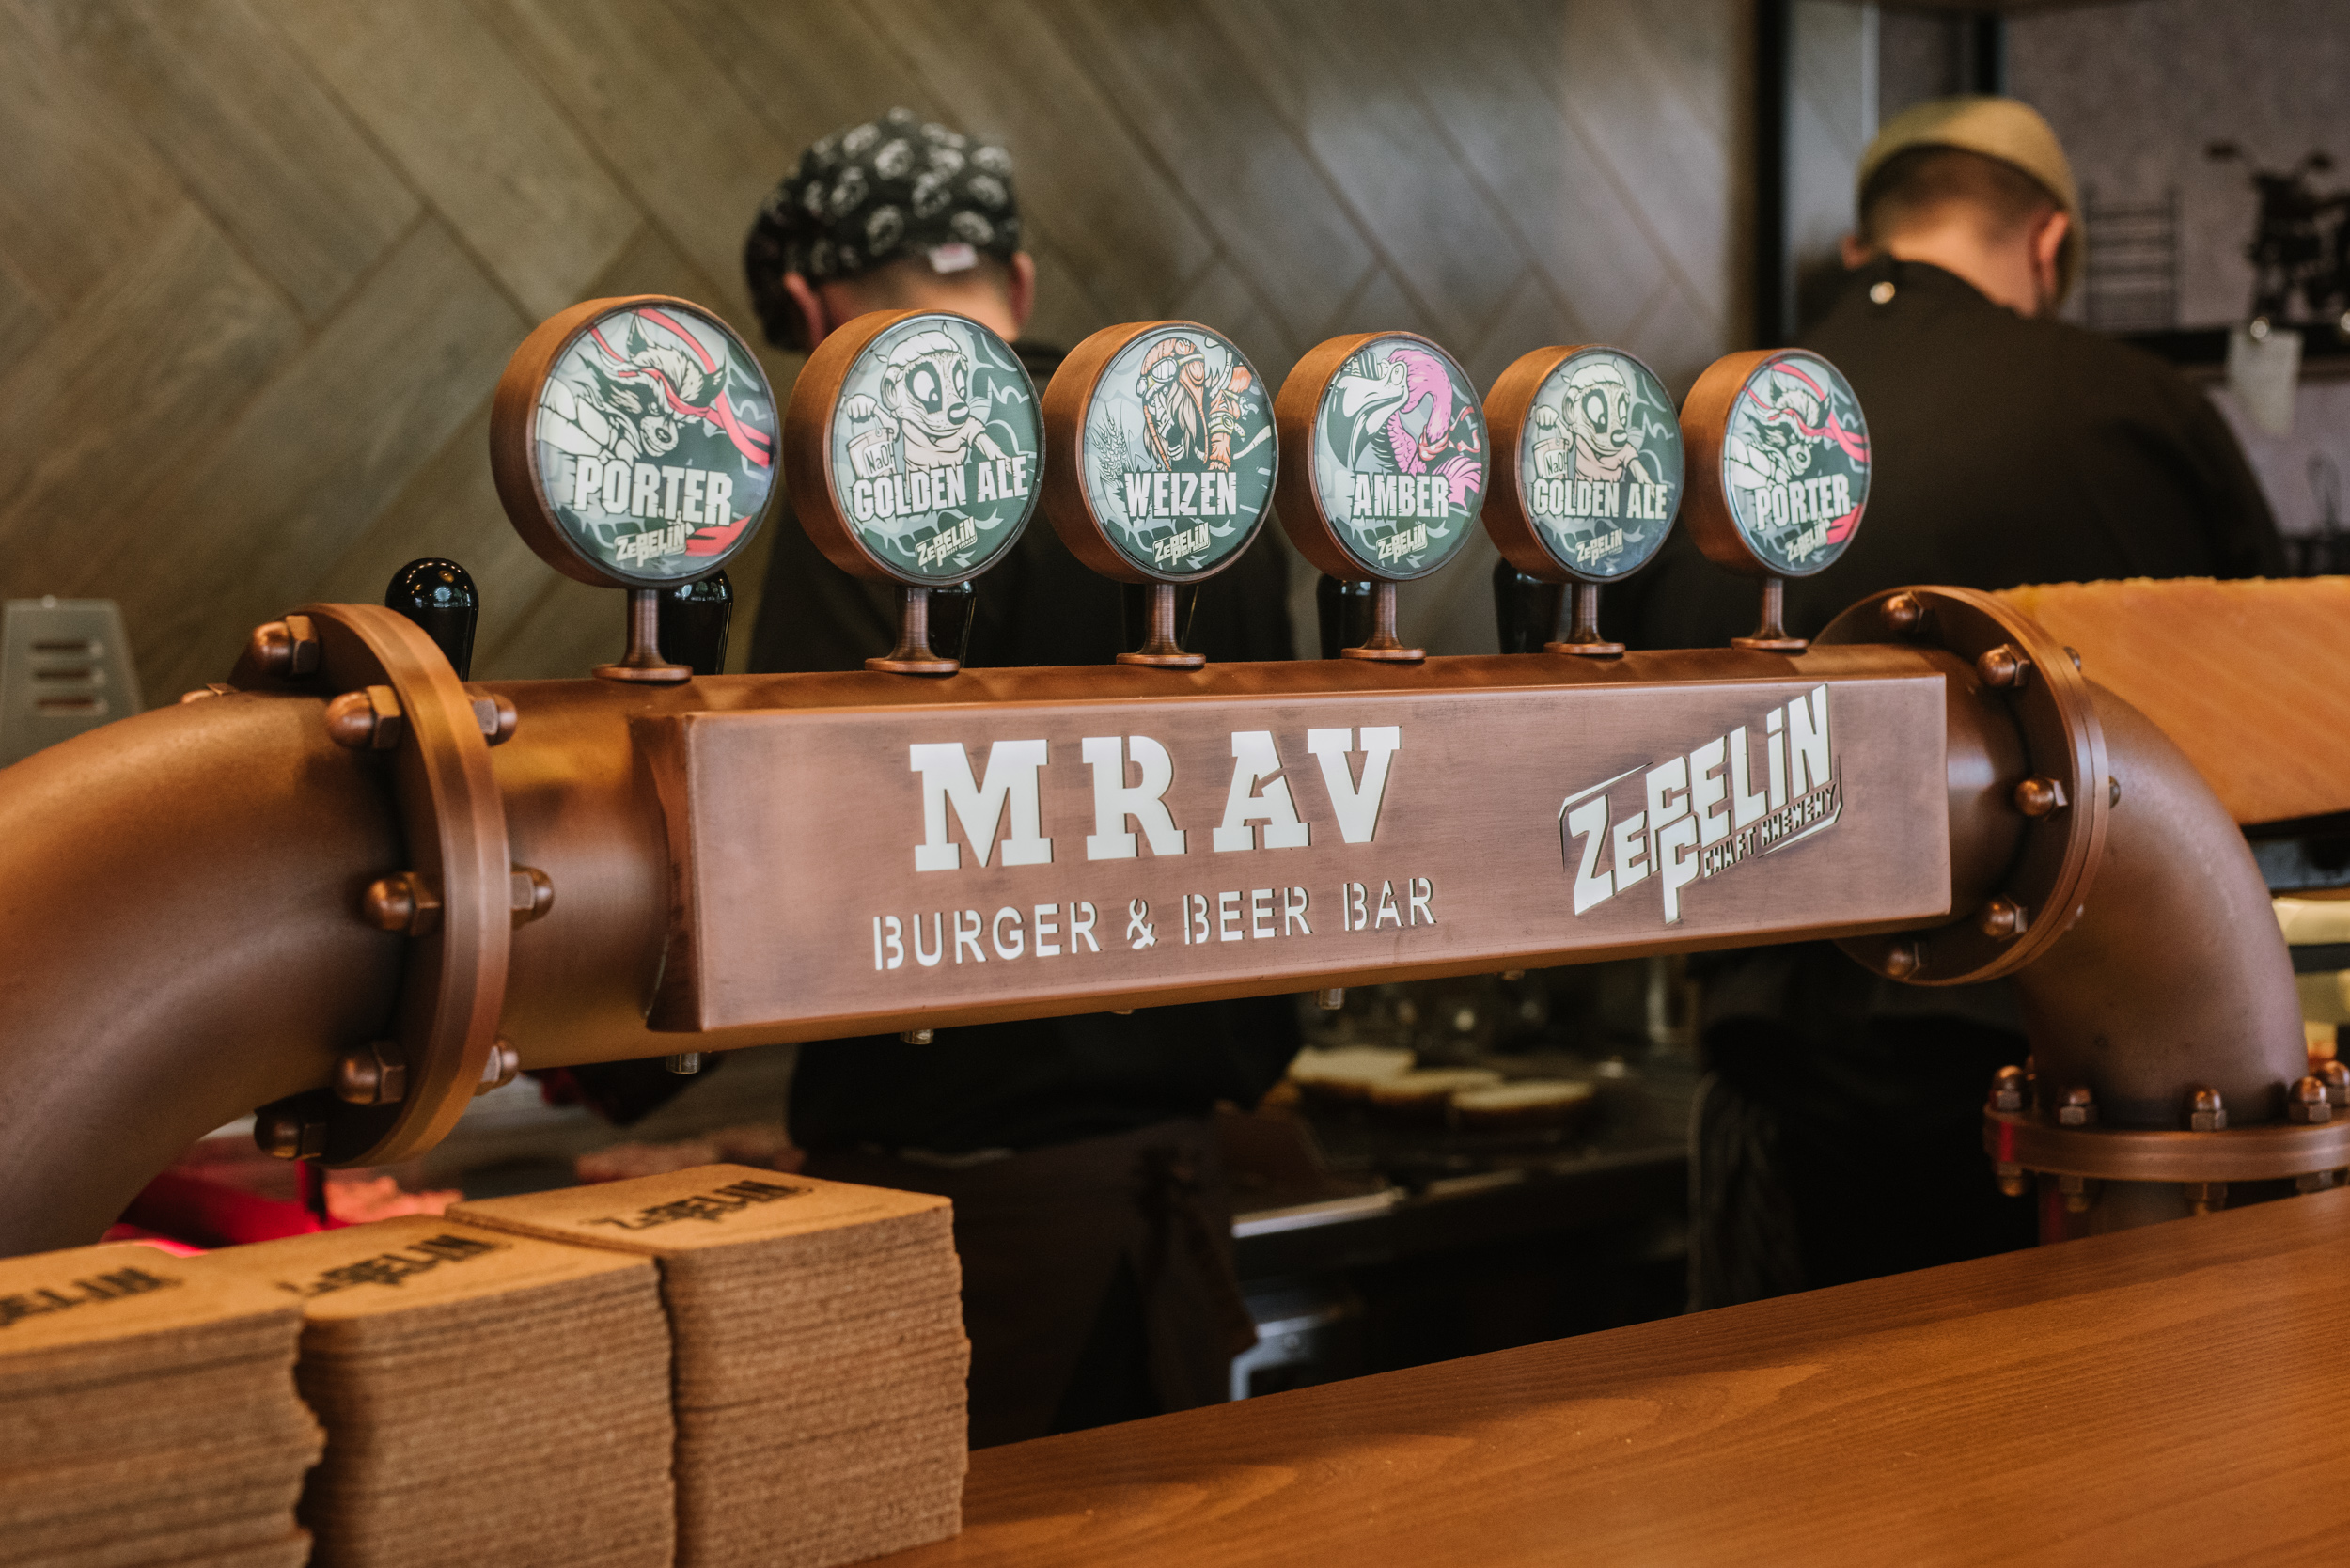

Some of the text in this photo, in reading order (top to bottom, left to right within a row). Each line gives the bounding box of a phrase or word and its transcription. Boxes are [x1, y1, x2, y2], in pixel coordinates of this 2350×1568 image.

[573, 457, 733, 526] PORTER
[853, 455, 1029, 522] GOLDEN ALE
[1124, 472, 1237, 517] WEIZEN
[1351, 475, 1449, 518] AMBER
[1532, 478, 1668, 521] GOLDEN ALE
[1757, 473, 1852, 531] PORTER
[909, 726, 1401, 872] MRAV
[1703, 783, 1837, 879] CRAFT BREWERY
[873, 876, 1437, 971] BURGER & BEER BAR
